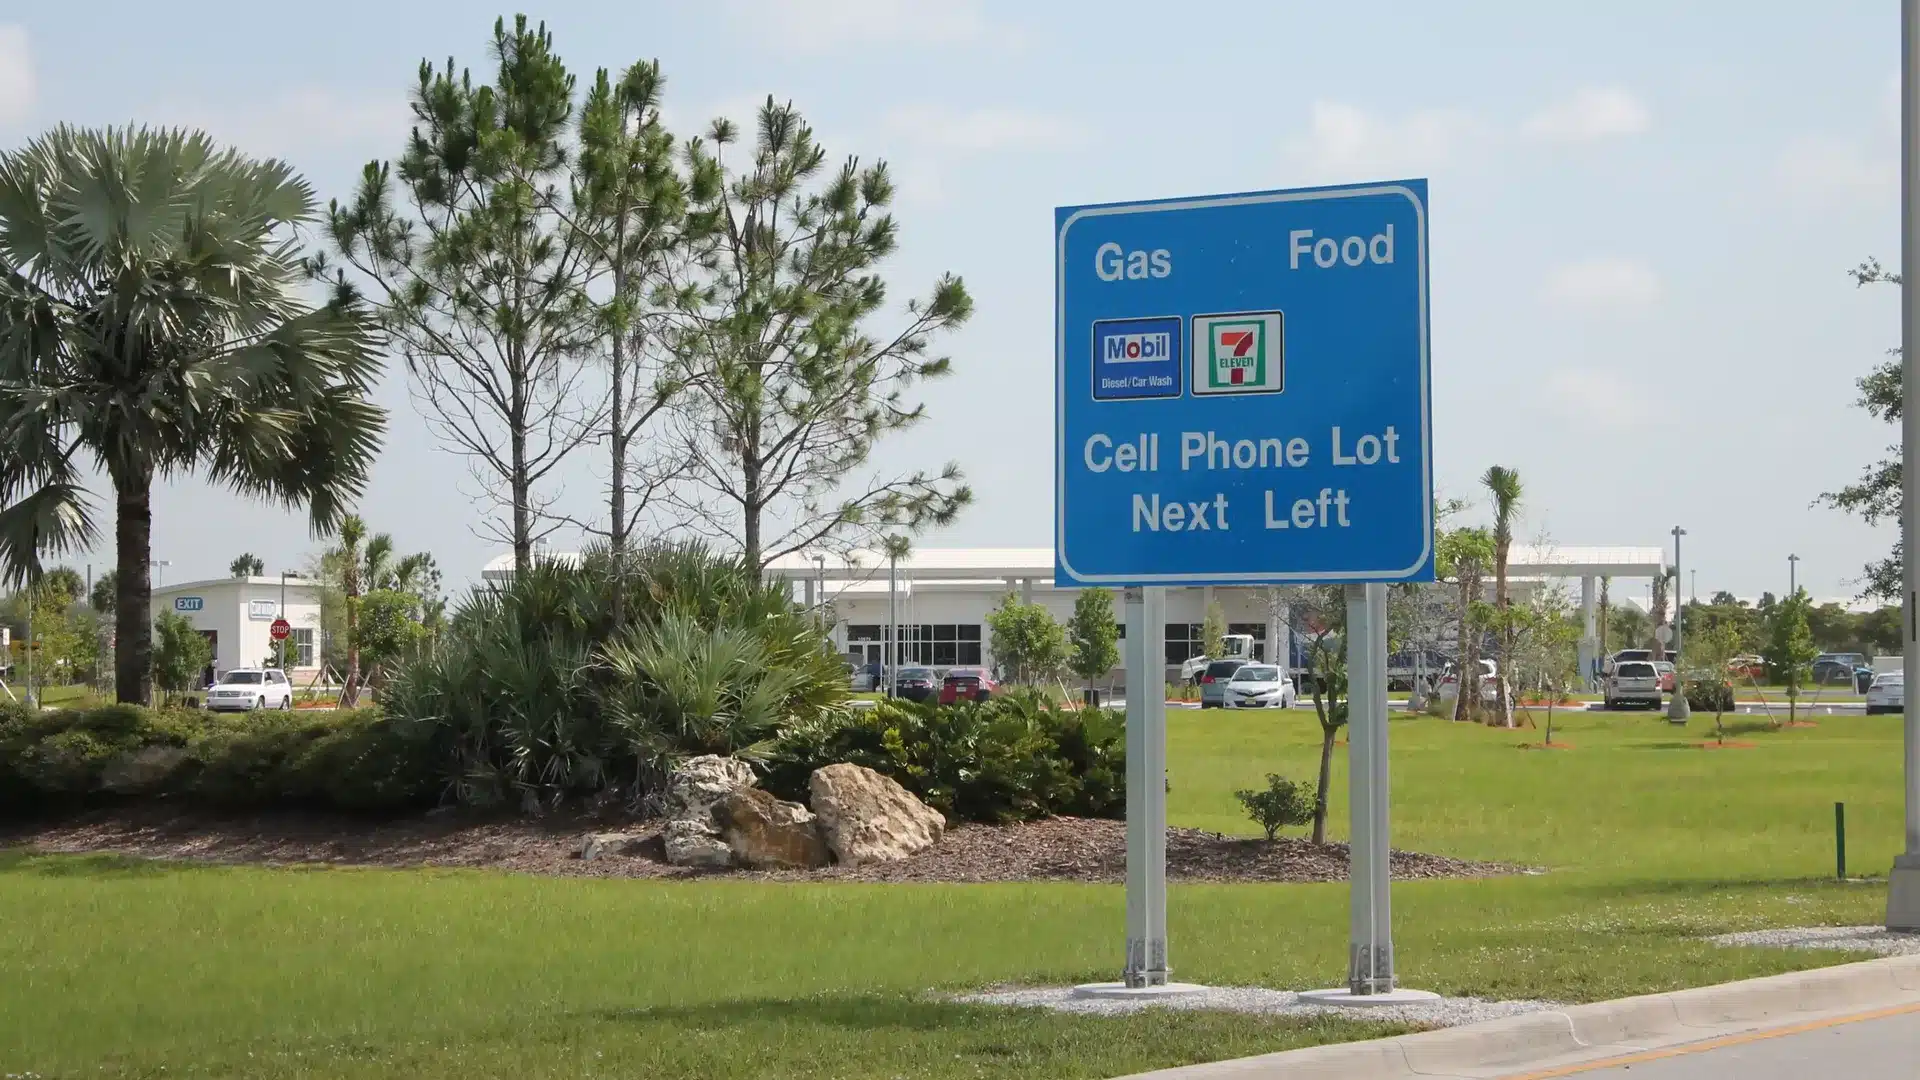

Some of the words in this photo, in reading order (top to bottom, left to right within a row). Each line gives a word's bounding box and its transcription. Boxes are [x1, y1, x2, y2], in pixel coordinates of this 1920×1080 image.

[1095, 242, 1172, 282] Gas
[1289, 223, 1395, 269] Food
[1107, 334, 1166, 360] Mobil
[1221, 331, 1254, 385] 7
[1149, 375, 1172, 387] Wash
[1084, 432, 1158, 473] Cell
[1181, 430, 1310, 471] Phone
[1331, 425, 1400, 466] Lot
[1132, 493, 1229, 532] Next
[1264, 487, 1351, 529] Left
[177, 598, 201, 609] EXIT
[271, 625, 290, 634] STOP
